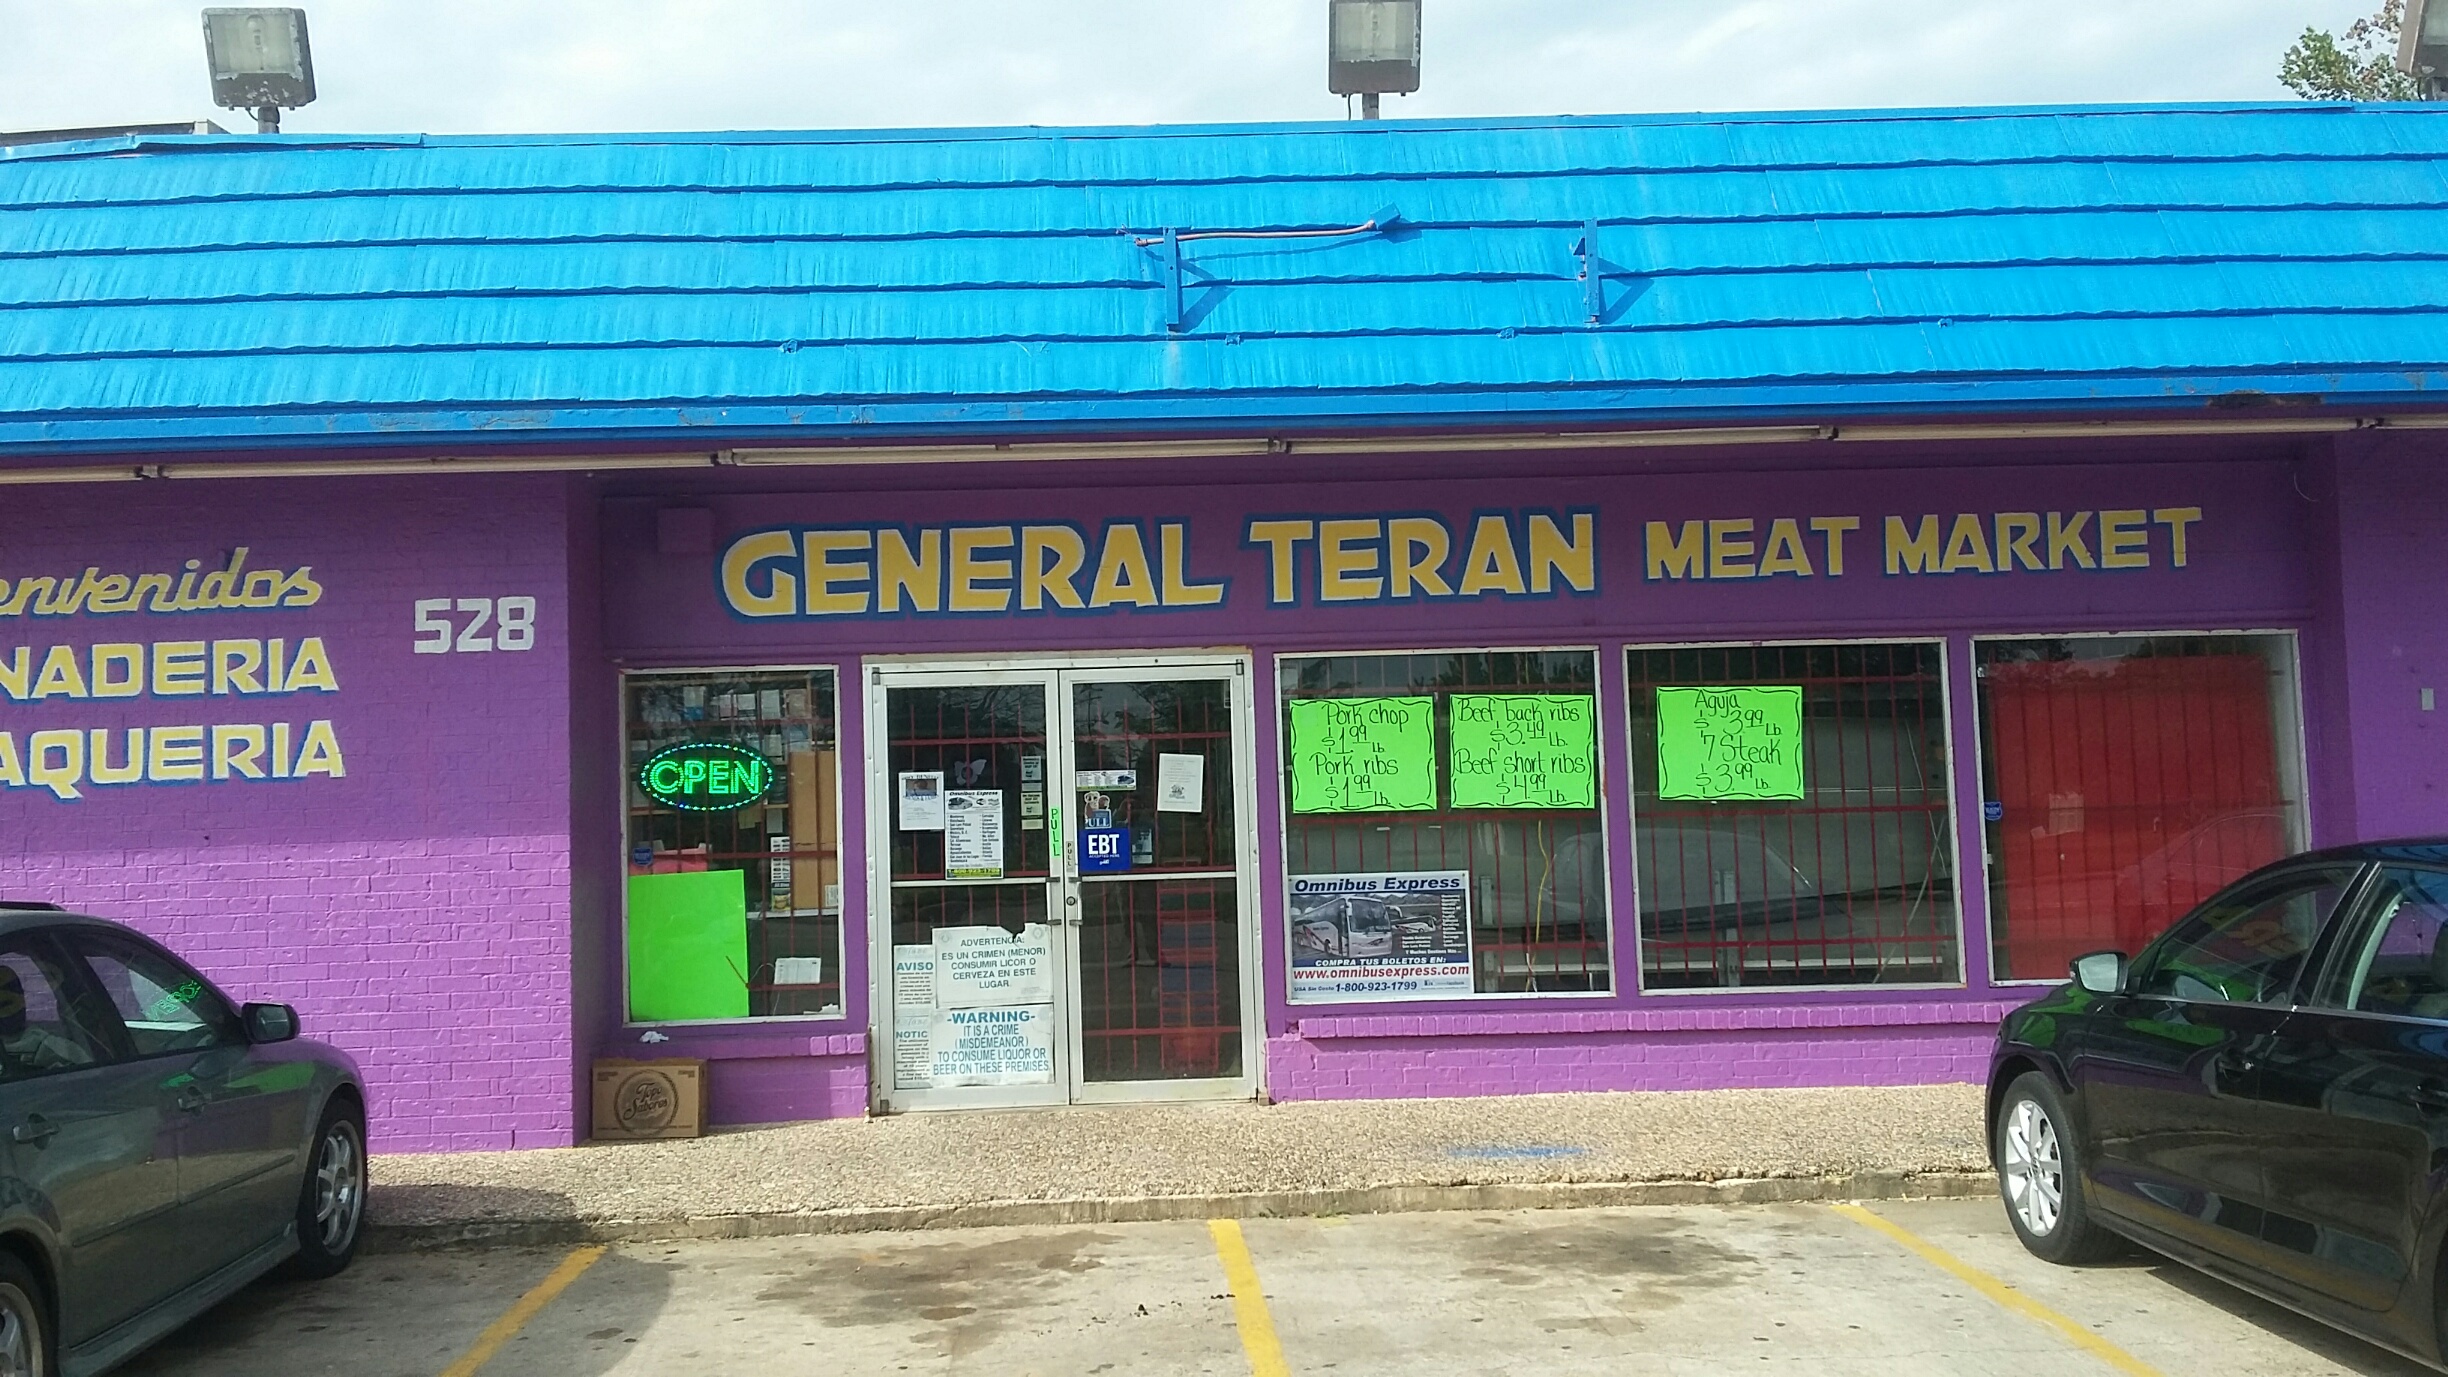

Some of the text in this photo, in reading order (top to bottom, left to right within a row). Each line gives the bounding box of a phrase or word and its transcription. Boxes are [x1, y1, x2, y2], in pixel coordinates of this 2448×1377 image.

[721, 506, 2202, 617] GENERAL TERAN MEAT MARKET
[0, 547, 323, 616] nvenidos
[413, 596, 535, 654] 528
[1457, 698, 1581, 722] Beef back ribs
[1694, 689, 1741, 718] Aguja
[1321, 702, 1409, 733] Pork chop
[1703, 734, 1782, 766] 7 Steak
[1308, 751, 1399, 776] Pork ribs
[1453, 747, 1587, 775] Beef short ribs
[650, 760, 760, 794] OPEN
[1050, 808, 1061, 857] PULL
[1087, 833, 1120, 855] EBT
[1294, 876, 1461, 892] Omnibus Express
[941, 947, 1046, 961] ES UN CRIMEN (MENOR)
[951, 957, 1037, 970] CONSUMIR LICOR O
[1315, 956, 1447, 967] COMPRA TUS BOLETOS EN:
[896, 962, 934, 971] AVISO
[952, 967, 1037, 980] CERVEZA EN ESTE
[1293, 965, 1469, 979] www.omnibusexpress.com
[1335, 981, 1417, 992] 1-800-923-1799
[895, 1031, 929, 1039] NOTIC
[963, 1023, 1019, 1037] IT IS A CRIME
[938, 1047, 1047, 1062] TO CONSUME LIQUOR OR
[933, 1063, 957, 1075] BEER
[959, 1063, 972, 1074] ON
[974, 1061, 1003, 1073] THESE
